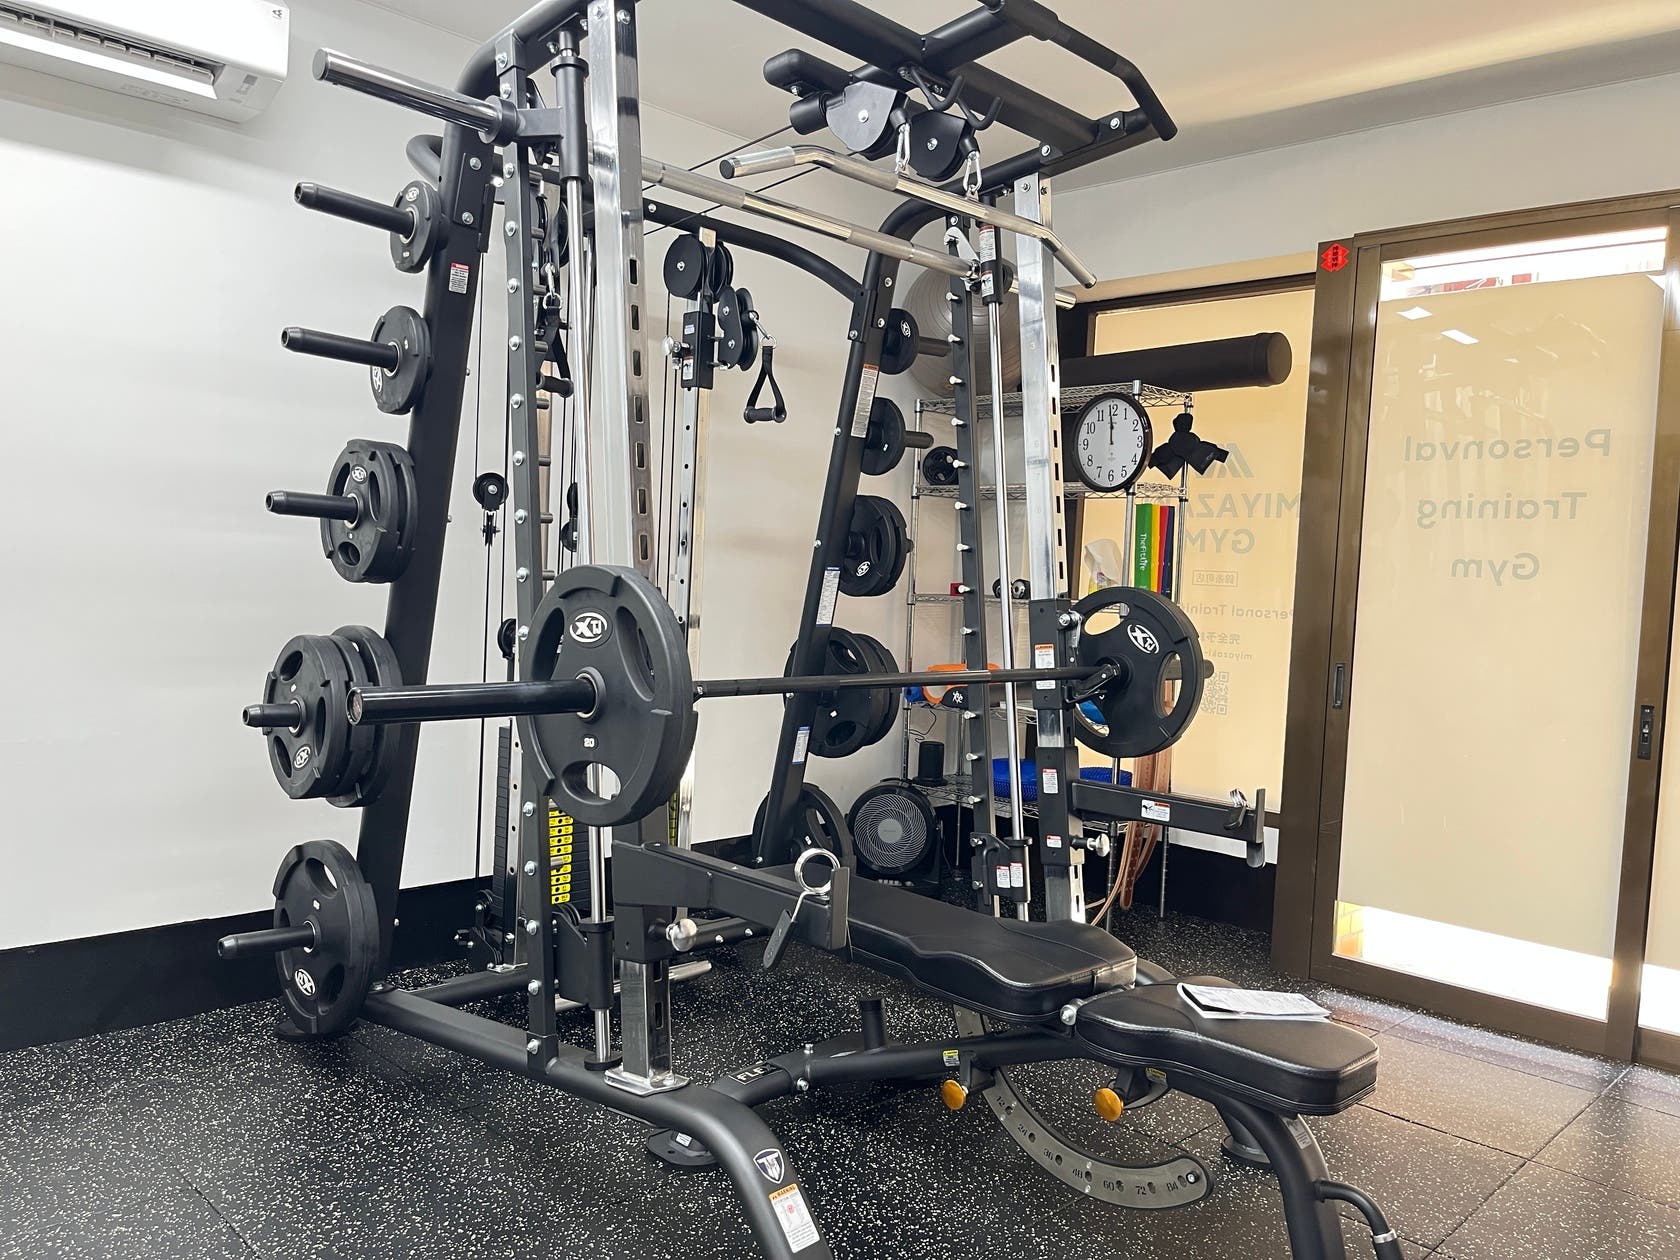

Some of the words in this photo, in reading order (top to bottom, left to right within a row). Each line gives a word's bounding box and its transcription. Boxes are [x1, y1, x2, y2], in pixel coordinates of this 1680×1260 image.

[1097, 409, 1104, 421] 11
[1109, 404, 1118, 416] 12
[1123, 408, 1127, 420] 1
[1086, 422, 1095, 434] 10
[1132, 419, 1138, 431] 2
[1082, 439, 1089, 450] 9
[1137, 436, 1143, 448] 3
[1087, 455, 1093, 466] 8
[1131, 453, 1137, 465] 4
[1096, 466, 1102, 478] 7
[1108, 470, 1114, 482] 6
[1121, 466, 1127, 478] 5
[584, 738, 594, 748] 20
[1135, 1185, 1146, 1195] 72
